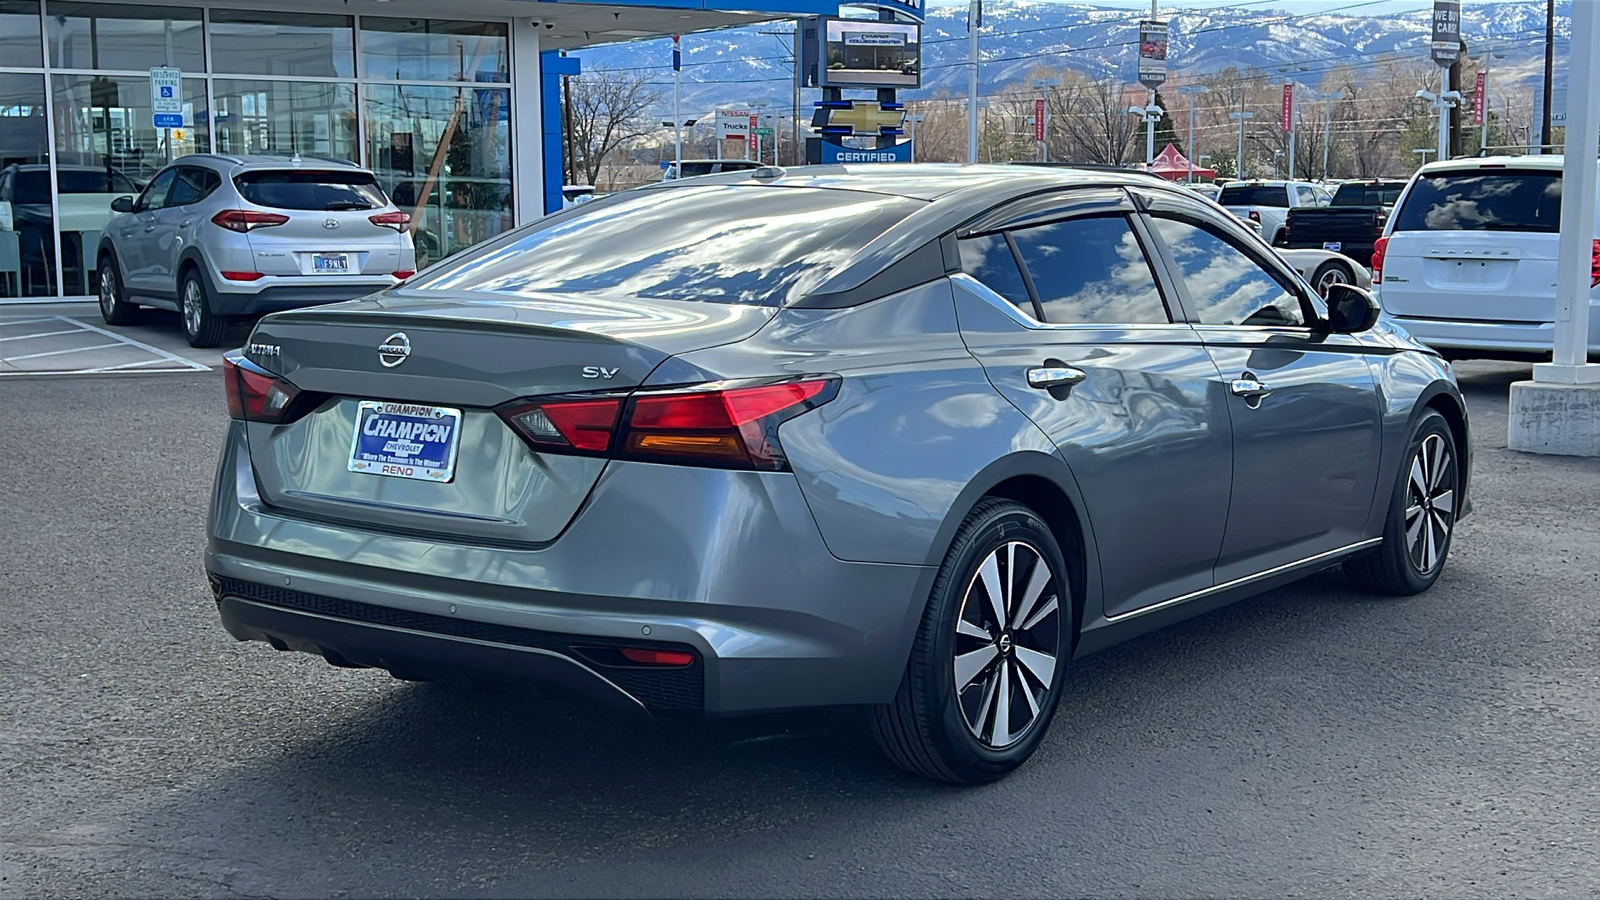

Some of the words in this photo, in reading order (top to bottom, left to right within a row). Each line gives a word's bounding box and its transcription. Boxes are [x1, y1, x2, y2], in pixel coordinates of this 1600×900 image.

[1435, 10, 1447, 21] WE
[1476, 86, 1484, 122] NISSAN
[721, 110, 749, 118] NISSAN
[723, 122, 748, 130] Trucks
[836, 152, 896, 162] CERTIFIED
[582, 366, 620, 379] SV
[385, 404, 433, 416] CHAMPION
[363, 414, 450, 443] CHAMPION
[386, 443, 420, 452] CHEVROLET
[378, 454, 387, 462] The
[387, 455, 410, 465] Customer
[414, 458, 424, 466] The
[382, 465, 413, 475] RENO
